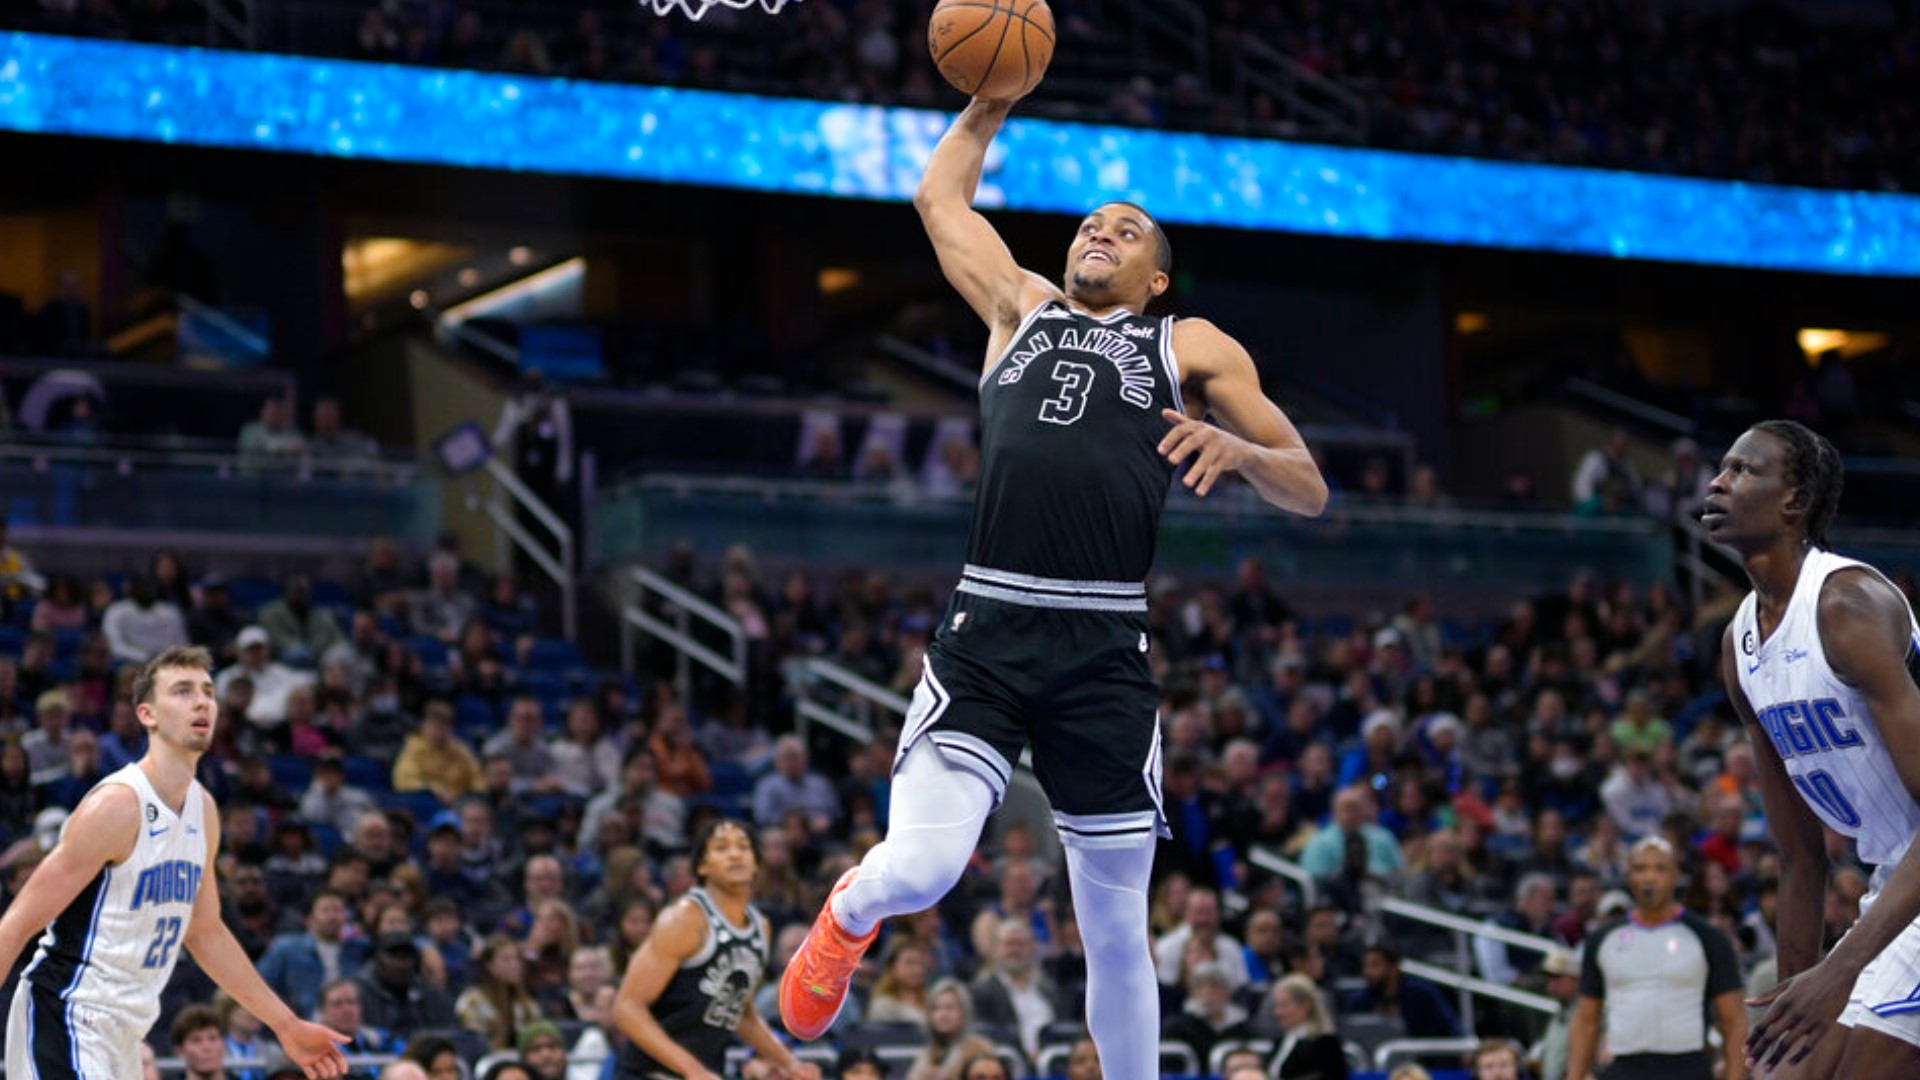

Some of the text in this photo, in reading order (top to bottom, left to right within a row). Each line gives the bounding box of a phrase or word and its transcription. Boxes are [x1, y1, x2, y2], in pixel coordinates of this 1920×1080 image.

[999, 327, 1155, 409] SAN ANTONIO
[1038, 360, 1096, 425] 3
[1755, 698, 1866, 761] AGIC
[143, 917, 181, 969] 22
